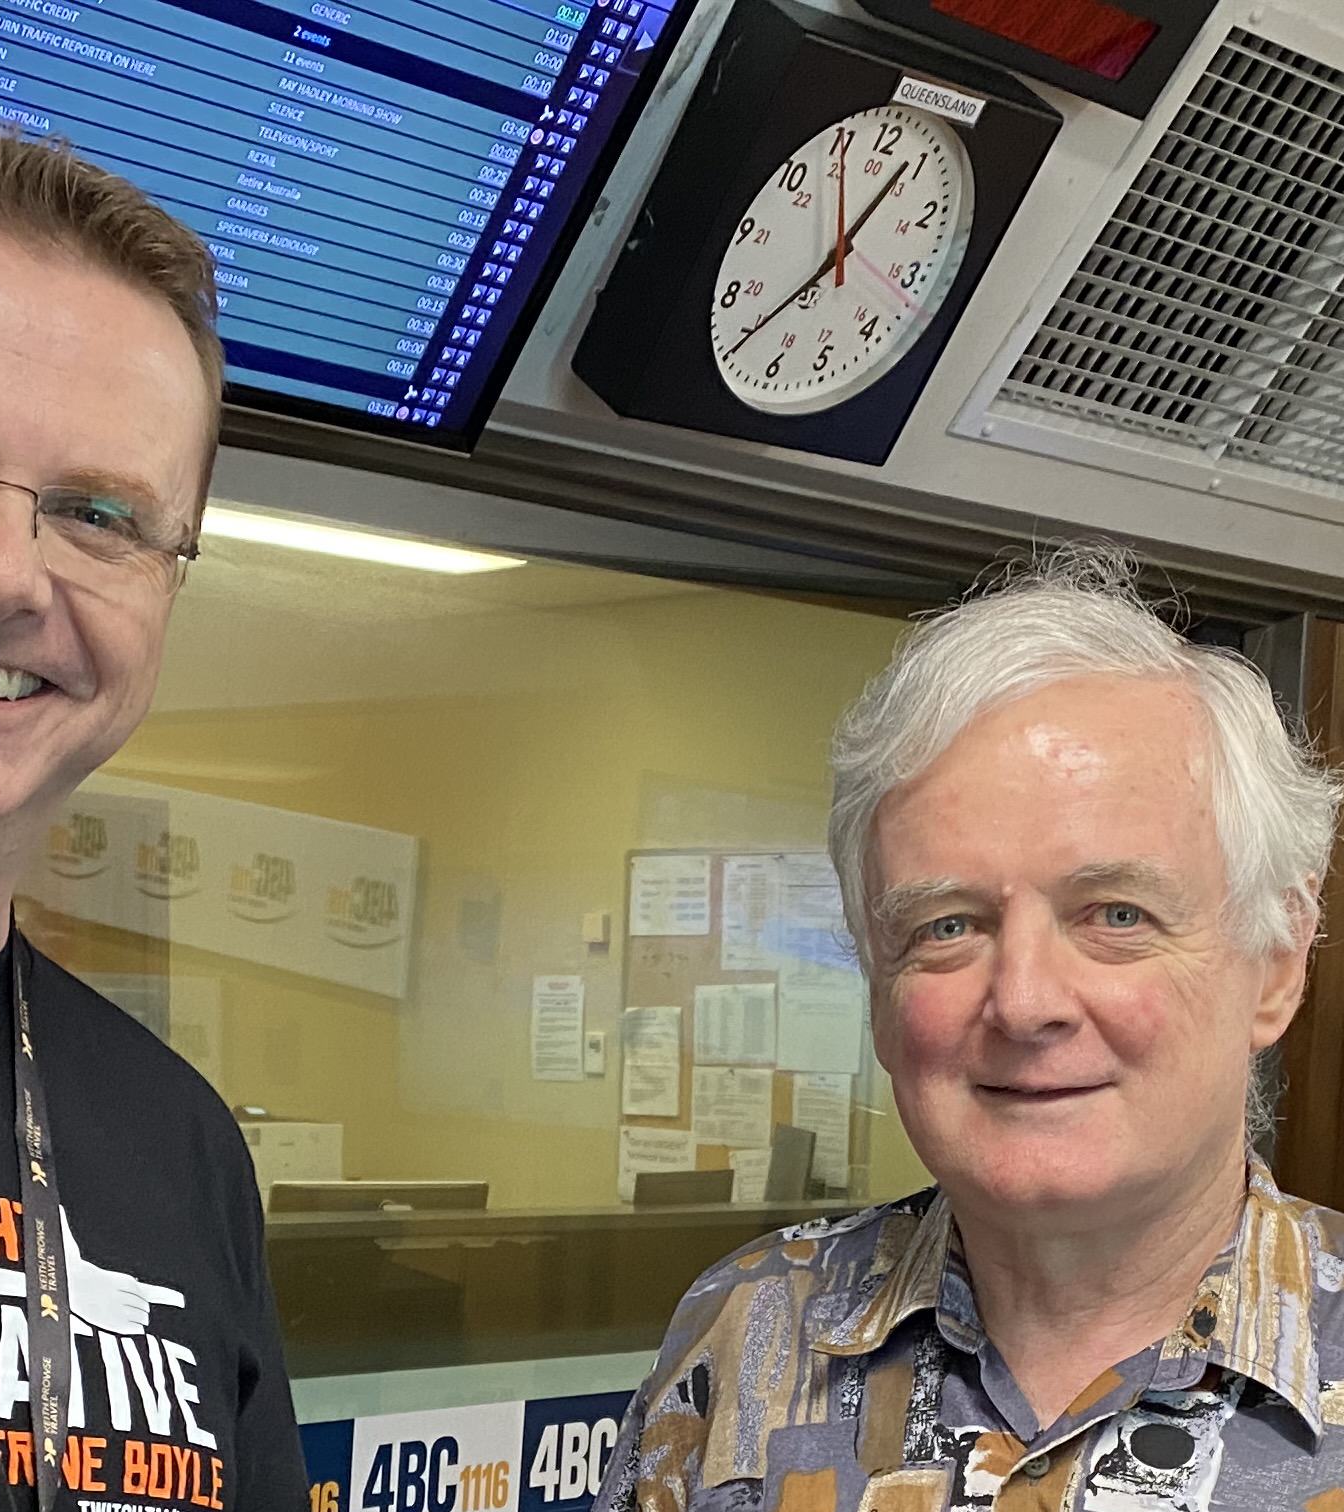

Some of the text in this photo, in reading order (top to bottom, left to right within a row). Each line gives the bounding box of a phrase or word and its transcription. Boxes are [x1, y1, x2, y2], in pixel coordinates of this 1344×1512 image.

[42, 3, 80, 23] CREDIT
[557, 5, 585, 23] 00:18
[293, 25, 331, 47] 2 events
[545, 28, 573, 47] 01:01
[21, 25, 61, 47] TRAFFIC
[61, 38, 112, 65] REPORTER
[113, 53, 130, 68] ON
[131, 58, 157, 77] HERE
[283, 51, 325, 73] 11 events
[535, 52, 562, 70] 00:00
[523, 75, 552, 93] 00:10
[279, 78, 298, 91] RAY
[297, 84, 332, 102] HADLEY
[374, 107, 402, 124] SHOW
[901, 83, 977, 116] QUEENSLAND
[268, 102, 304, 121] SILENCE
[501, 121, 529, 139] 03:40
[872, 123, 902, 156] 12
[247, 150, 277, 167] RETAIL
[490, 144, 519, 161] 00:05
[778, 159, 807, 192] 10
[864, 159, 883, 176] 00
[912, 152, 928, 181] 1
[237, 174, 301, 200] Retire Australia
[469, 188, 497, 206] 00:30
[792, 192, 812, 208] 22
[227, 197, 269, 217] GARAGES
[915, 201, 938, 229] 2
[458, 210, 487, 228] 00:15
[895, 219, 910, 235] 14
[216, 221, 320, 256] SPECSAVERS AUDIOLOGY
[448, 232, 476, 249] 00:29
[735, 217, 755, 245] 9
[753, 228, 771, 246] 21
[437, 254, 465, 271] 00:30
[888, 263, 902, 279] 15
[427, 276, 455, 292] 00:30
[901, 261, 921, 289] 3
[720, 281, 742, 309] 8
[743, 280, 764, 297] 20
[417, 297, 445, 313] 00:15
[854, 306, 868, 322] 16
[407, 318, 435, 334] 00:30
[817, 328, 833, 343] 17
[859, 315, 879, 342] 4
[397, 339, 425, 354] 00:00
[781, 332, 797, 349] 18
[387, 360, 414, 375] 00:10
[765, 352, 785, 378] 6
[813, 345, 834, 371] 5
[368, 401, 395, 417] 03:10
[35, 1218, 48, 1292] KEITH PROWSE
[47, 1254, 58, 1293] TRAVEL
[41, 1356, 53, 1435] KEITH PROWSE
[50, 1395, 59, 1435] TRAVEL
[460, 1460, 510, 1512] 1116
[529, 1417, 618, 1502] 4BC
[122, 1442, 224, 1511] BOYLE
